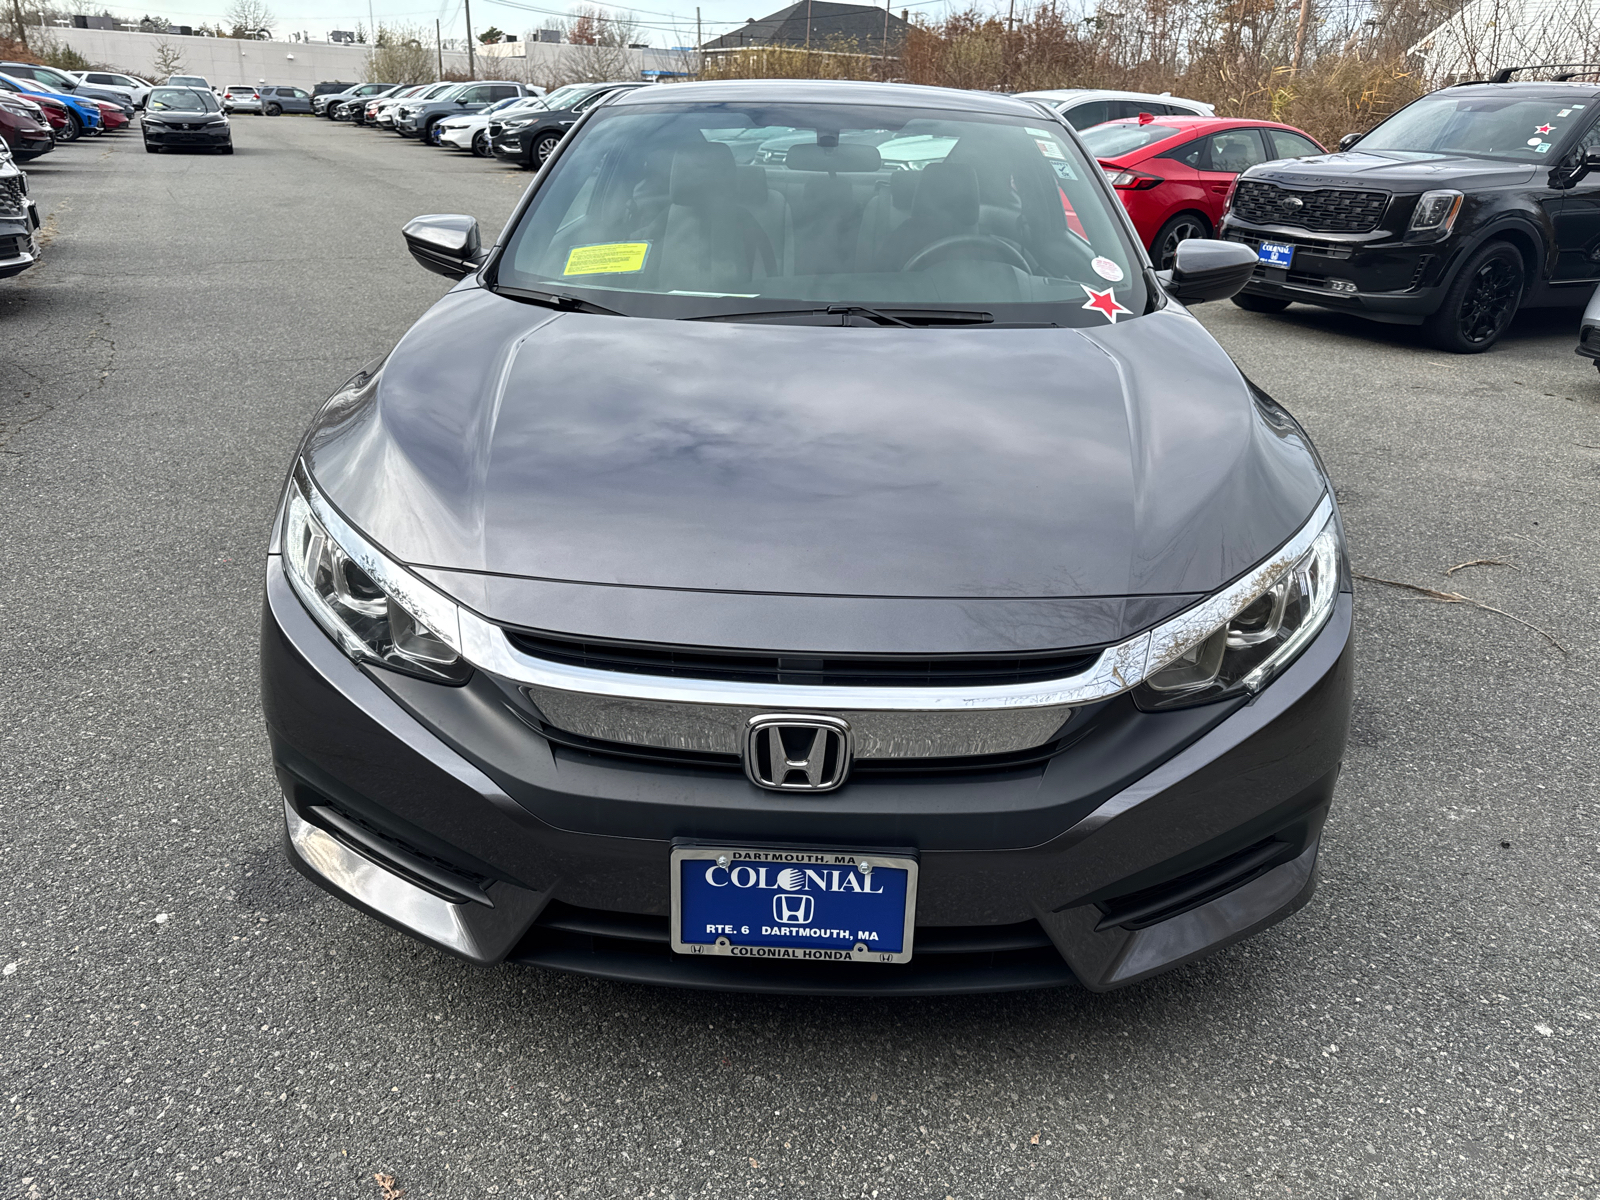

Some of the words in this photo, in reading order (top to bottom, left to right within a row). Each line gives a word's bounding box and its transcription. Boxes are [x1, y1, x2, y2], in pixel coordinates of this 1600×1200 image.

[732, 851, 830, 864] DARTMOUTH,
[834, 855, 856, 864] MA
[704, 865, 884, 894] COLONIAL
[706, 924, 737, 934] RTE.
[741, 925, 750, 935] 6
[761, 926, 854, 941] DARTMOUTH,
[857, 930, 879, 941] MA
[730, 946, 799, 958] COLONIAL
[803, 950, 852, 960] HONDA
